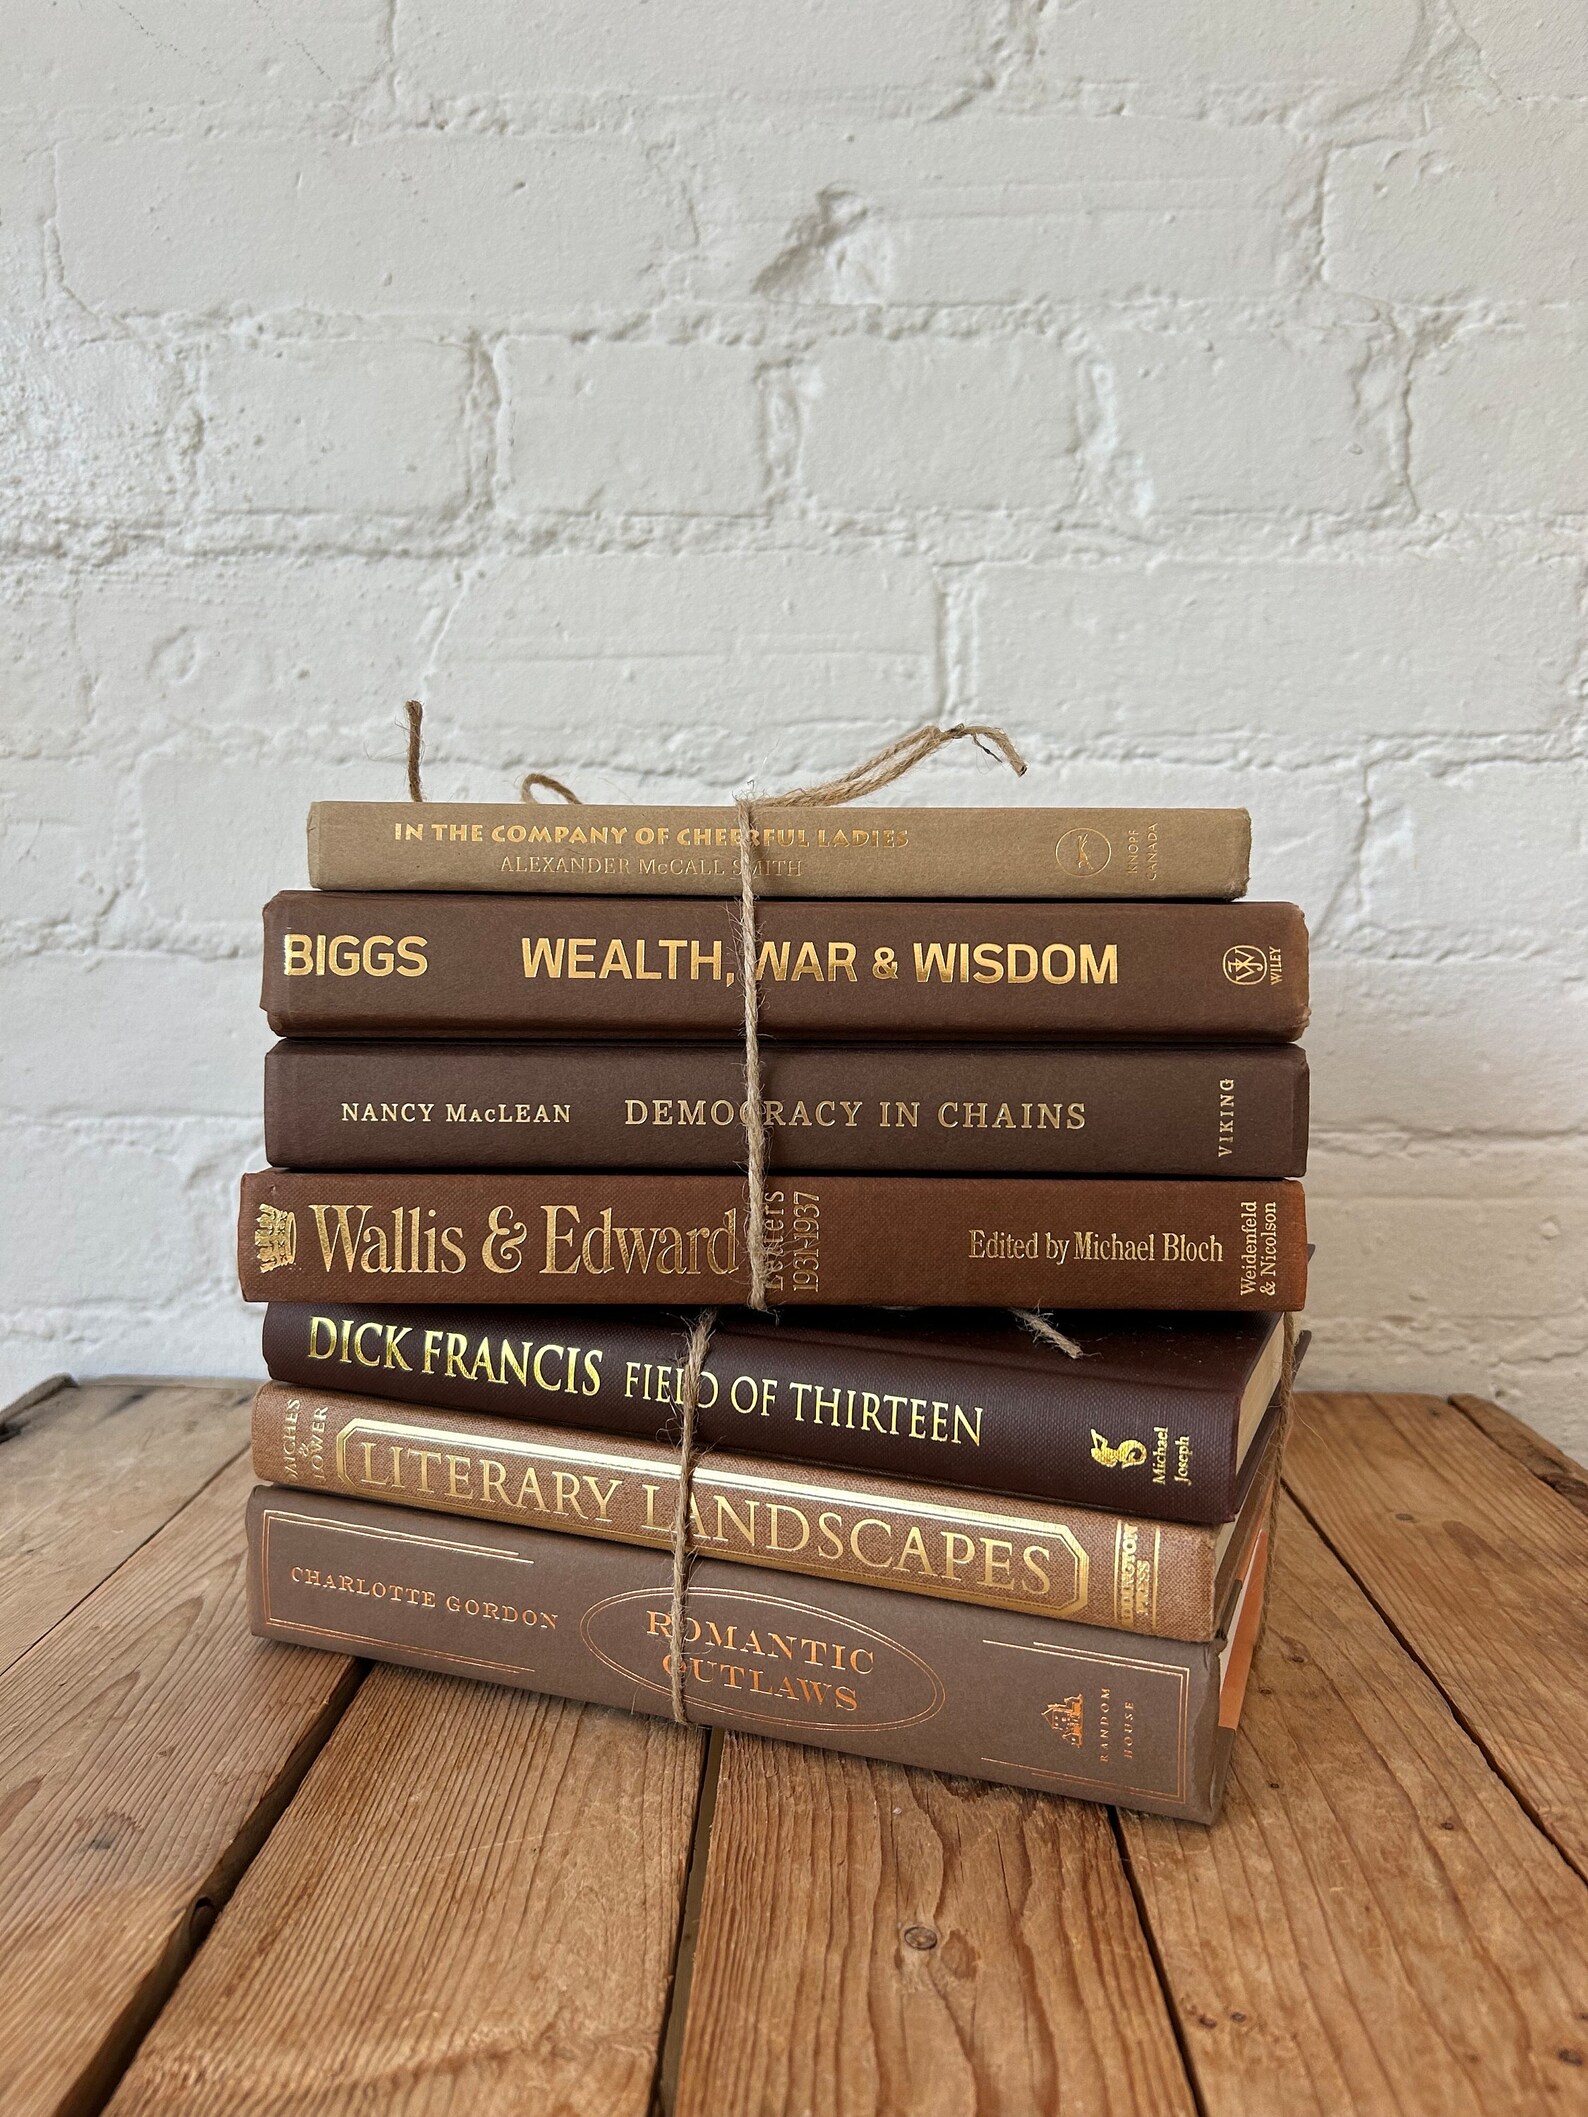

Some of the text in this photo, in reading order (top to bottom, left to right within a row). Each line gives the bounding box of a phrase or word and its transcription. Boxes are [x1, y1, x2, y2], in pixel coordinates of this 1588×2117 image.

[394, 823, 909, 849] IN THE COMPANY OF CHEERFUL LADIES
[1127, 830, 1139, 874] KNOPF
[1147, 823, 1158, 881] CANADA
[500, 856, 629, 874] ALEXANDER
[639, 858, 725, 876] McCALL
[283, 933, 428, 978] BIGGS
[521, 937, 1119, 988] WEALTH, WAR & WISDOM
[1269, 946, 1282, 985] WILEY
[340, 1102, 435, 1123] NANCY
[880, 1101, 919, 1127] IN
[937, 1102, 1087, 1131] CHAINS
[1218, 1078, 1234, 1157] VIKING
[308, 1203, 739, 1275] Wallis & Edward
[968, 1229, 1224, 1265] Edited by Michael Bloch
[1241, 1201, 1257, 1296] Weidenfeld
[1260, 1202, 1276, 1296] & Nicolson
[307, 1316, 603, 1396] DICK FRANCIS
[730, 1375, 779, 1416] OF
[789, 1382, 984, 1447] THIRTEEN
[1152, 1426, 1168, 1485] Michael
[1174, 1436, 1193, 1486] Joseph
[360, 1440, 1051, 1595] LITERARY LANDSCAPES
[291, 1566, 559, 1630] CHARLOTTE GORDON
[646, 1610, 875, 1674] ROMANTIC
[662, 1653, 857, 1711] OUTLAWS
[1100, 1687, 1110, 1762] RANDOM
[1123, 1701, 1134, 1759] HOUSE
